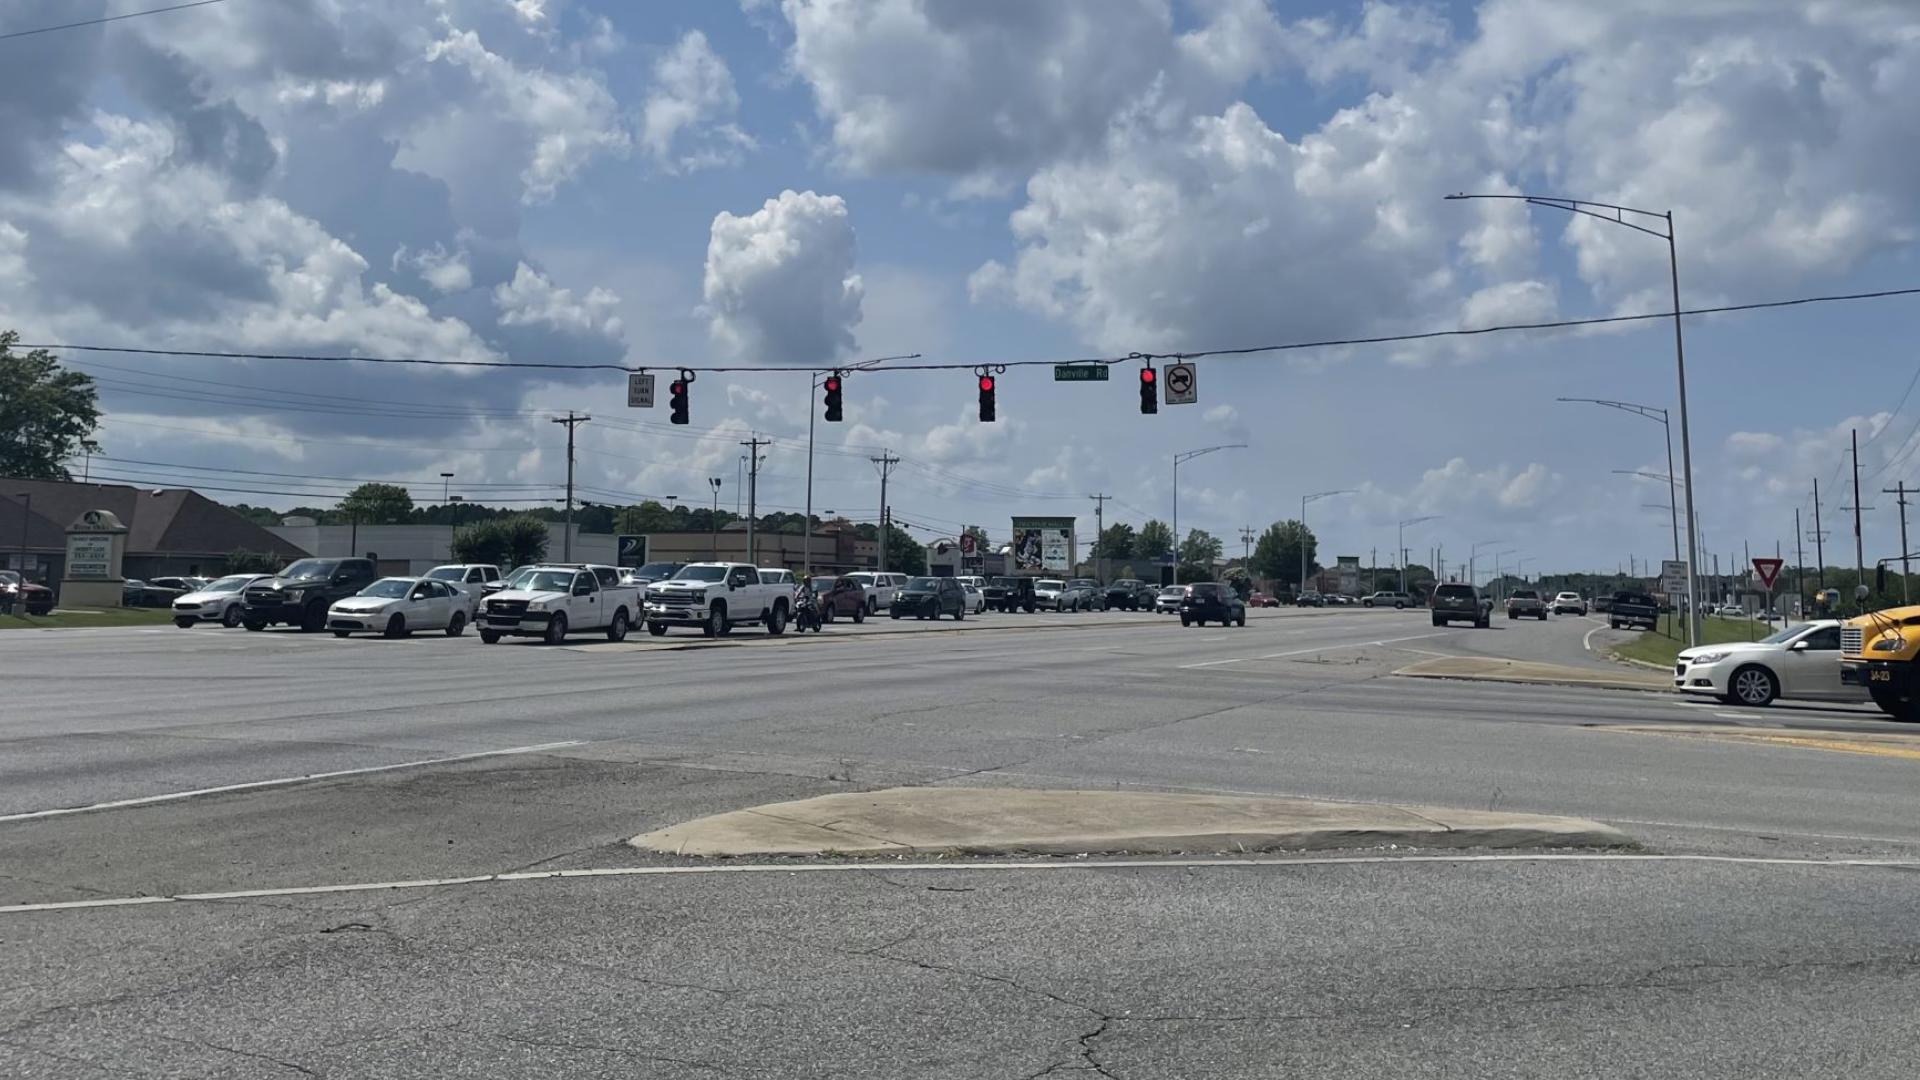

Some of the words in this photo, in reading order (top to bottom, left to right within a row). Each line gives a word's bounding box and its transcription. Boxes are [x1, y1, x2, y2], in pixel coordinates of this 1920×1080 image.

[1056, 368, 1089, 379] Danville
[1096, 368, 1108, 379] Rd
[635, 377, 649, 385] LEFT
